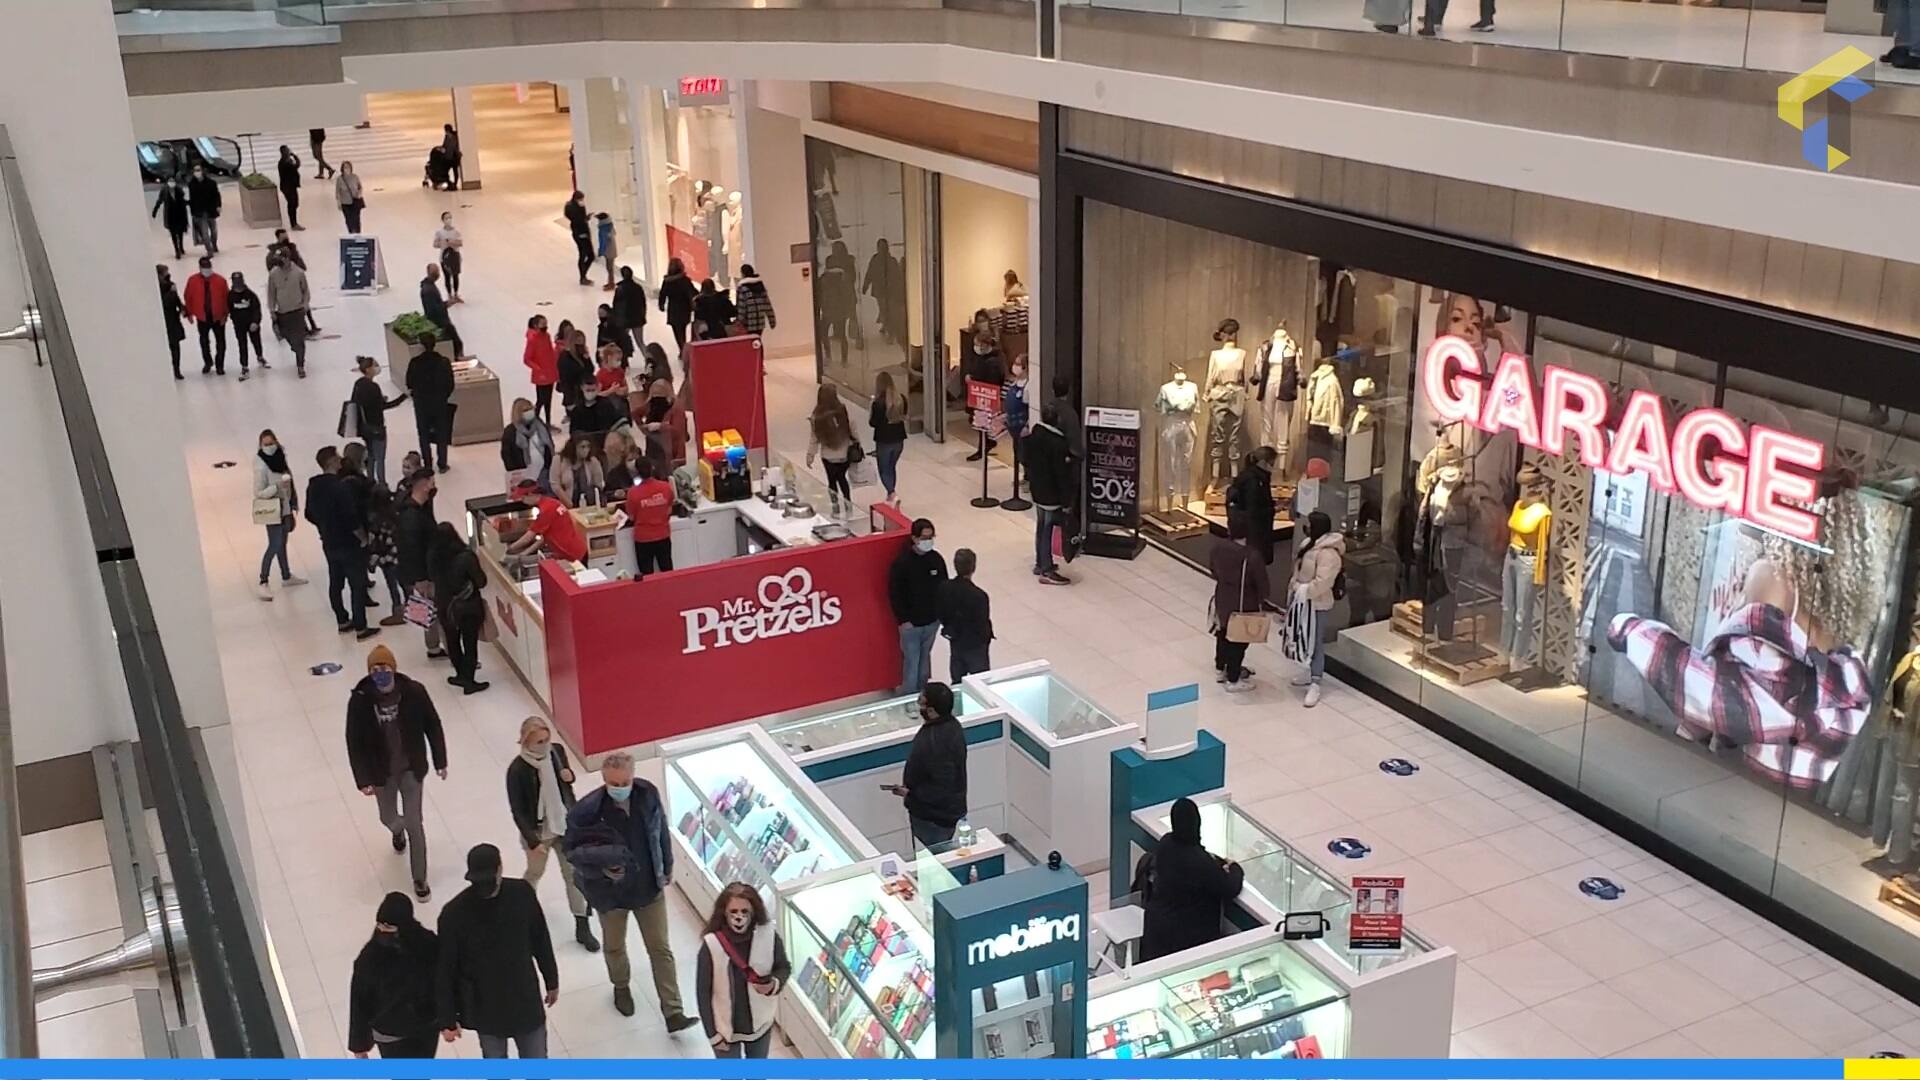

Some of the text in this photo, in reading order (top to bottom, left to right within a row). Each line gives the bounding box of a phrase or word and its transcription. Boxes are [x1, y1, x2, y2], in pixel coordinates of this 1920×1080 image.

[1090, 431, 1136, 448] LEGGINGS
[1423, 335, 1824, 542] GARAGE
[1090, 451, 1136, 467] JEGGINGS
[1090, 477, 1136, 502] 50%
[722, 597, 756, 618] Mr.
[679, 591, 842, 654] Pretzels
[967, 913, 1080, 966] mobilinq
